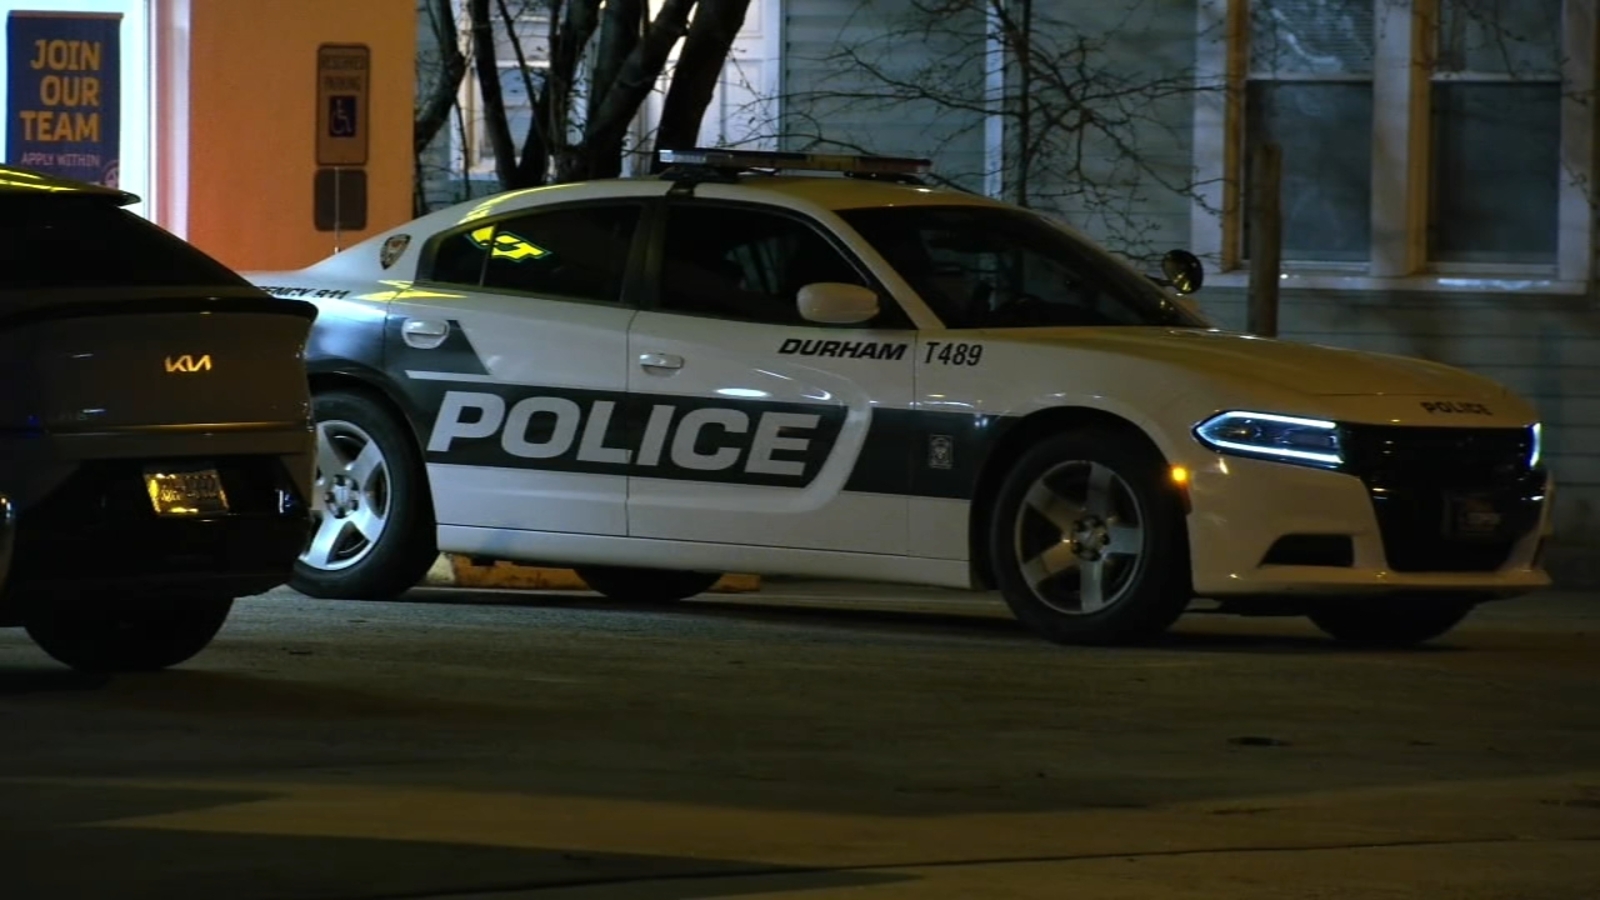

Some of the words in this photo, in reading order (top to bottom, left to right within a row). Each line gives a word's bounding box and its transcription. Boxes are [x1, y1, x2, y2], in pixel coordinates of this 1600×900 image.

[30, 39, 101, 71] JOIN
[40, 75, 100, 107] OUR
[19, 110, 100, 143] TEAM
[20, 152, 54, 166] APPLY
[57, 153, 100, 168] WITHIN
[312, 289, 351, 300] 911
[778, 338, 907, 360] DURHAM
[924, 342, 983, 366] T489
[164, 353, 213, 373] KIA
[1420, 401, 1493, 416] POLICE
[426, 389, 823, 476] POLICE
